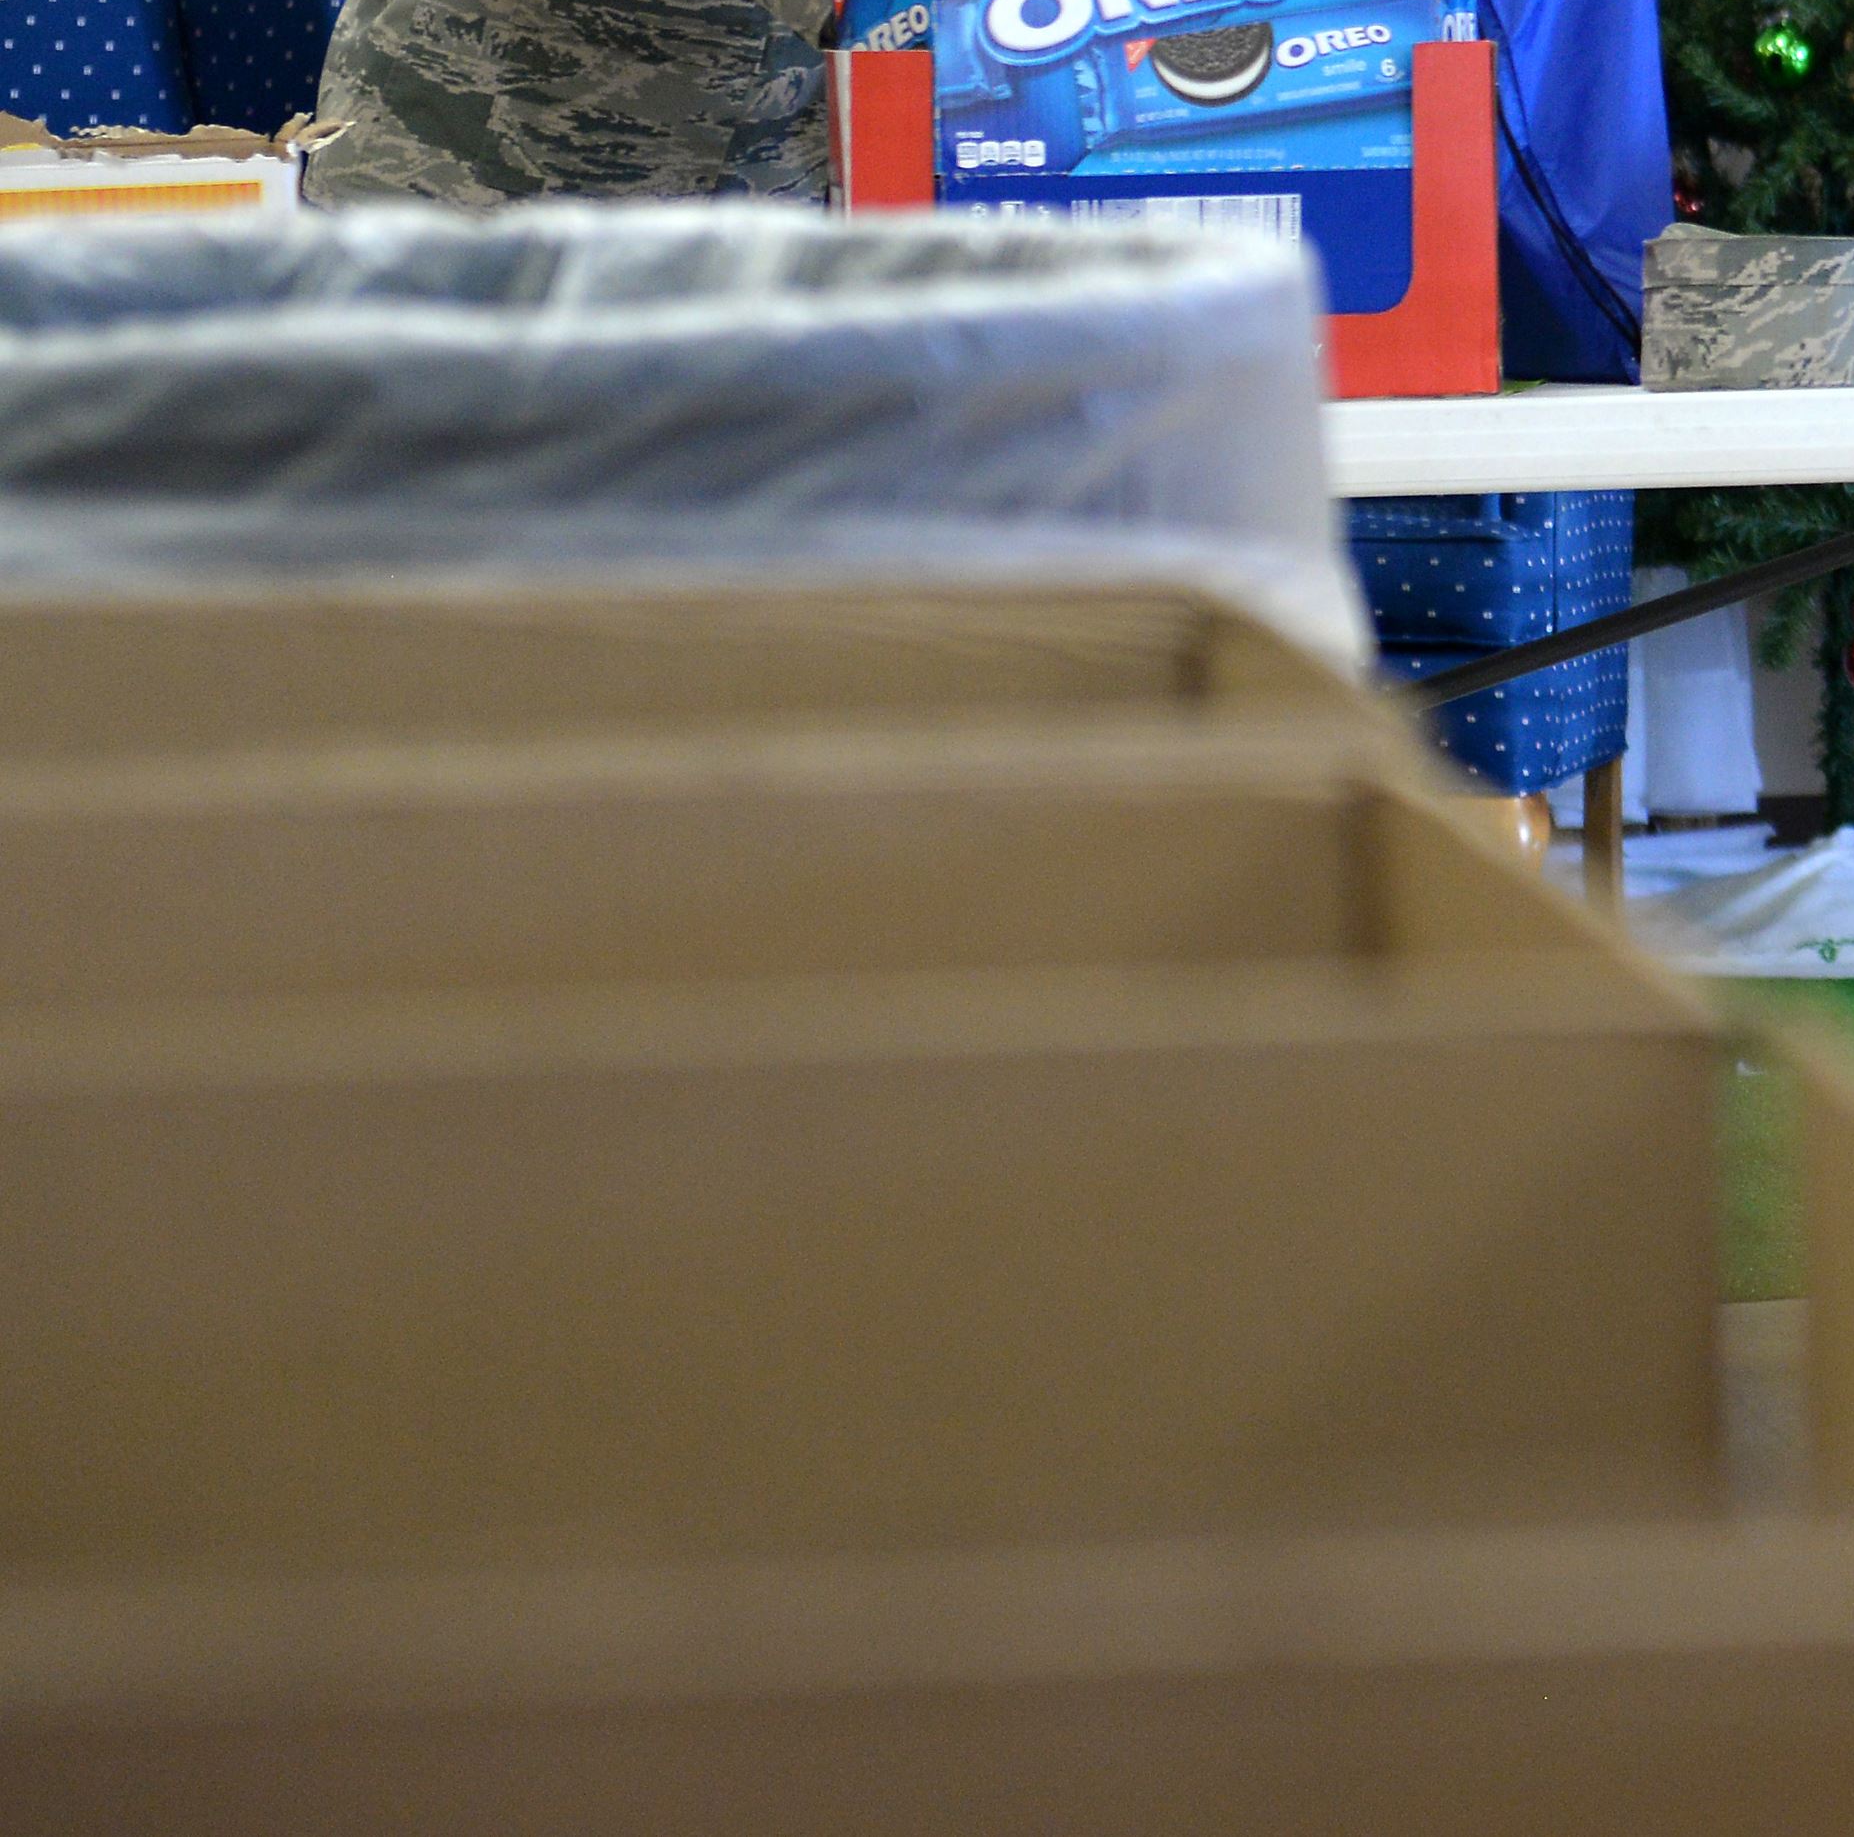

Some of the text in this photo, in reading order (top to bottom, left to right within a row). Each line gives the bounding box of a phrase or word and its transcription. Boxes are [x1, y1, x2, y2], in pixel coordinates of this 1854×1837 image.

[851, 4, 930, 51] REO
[1276, 24, 1392, 69] OREO
[1380, 58, 1397, 77] 6
